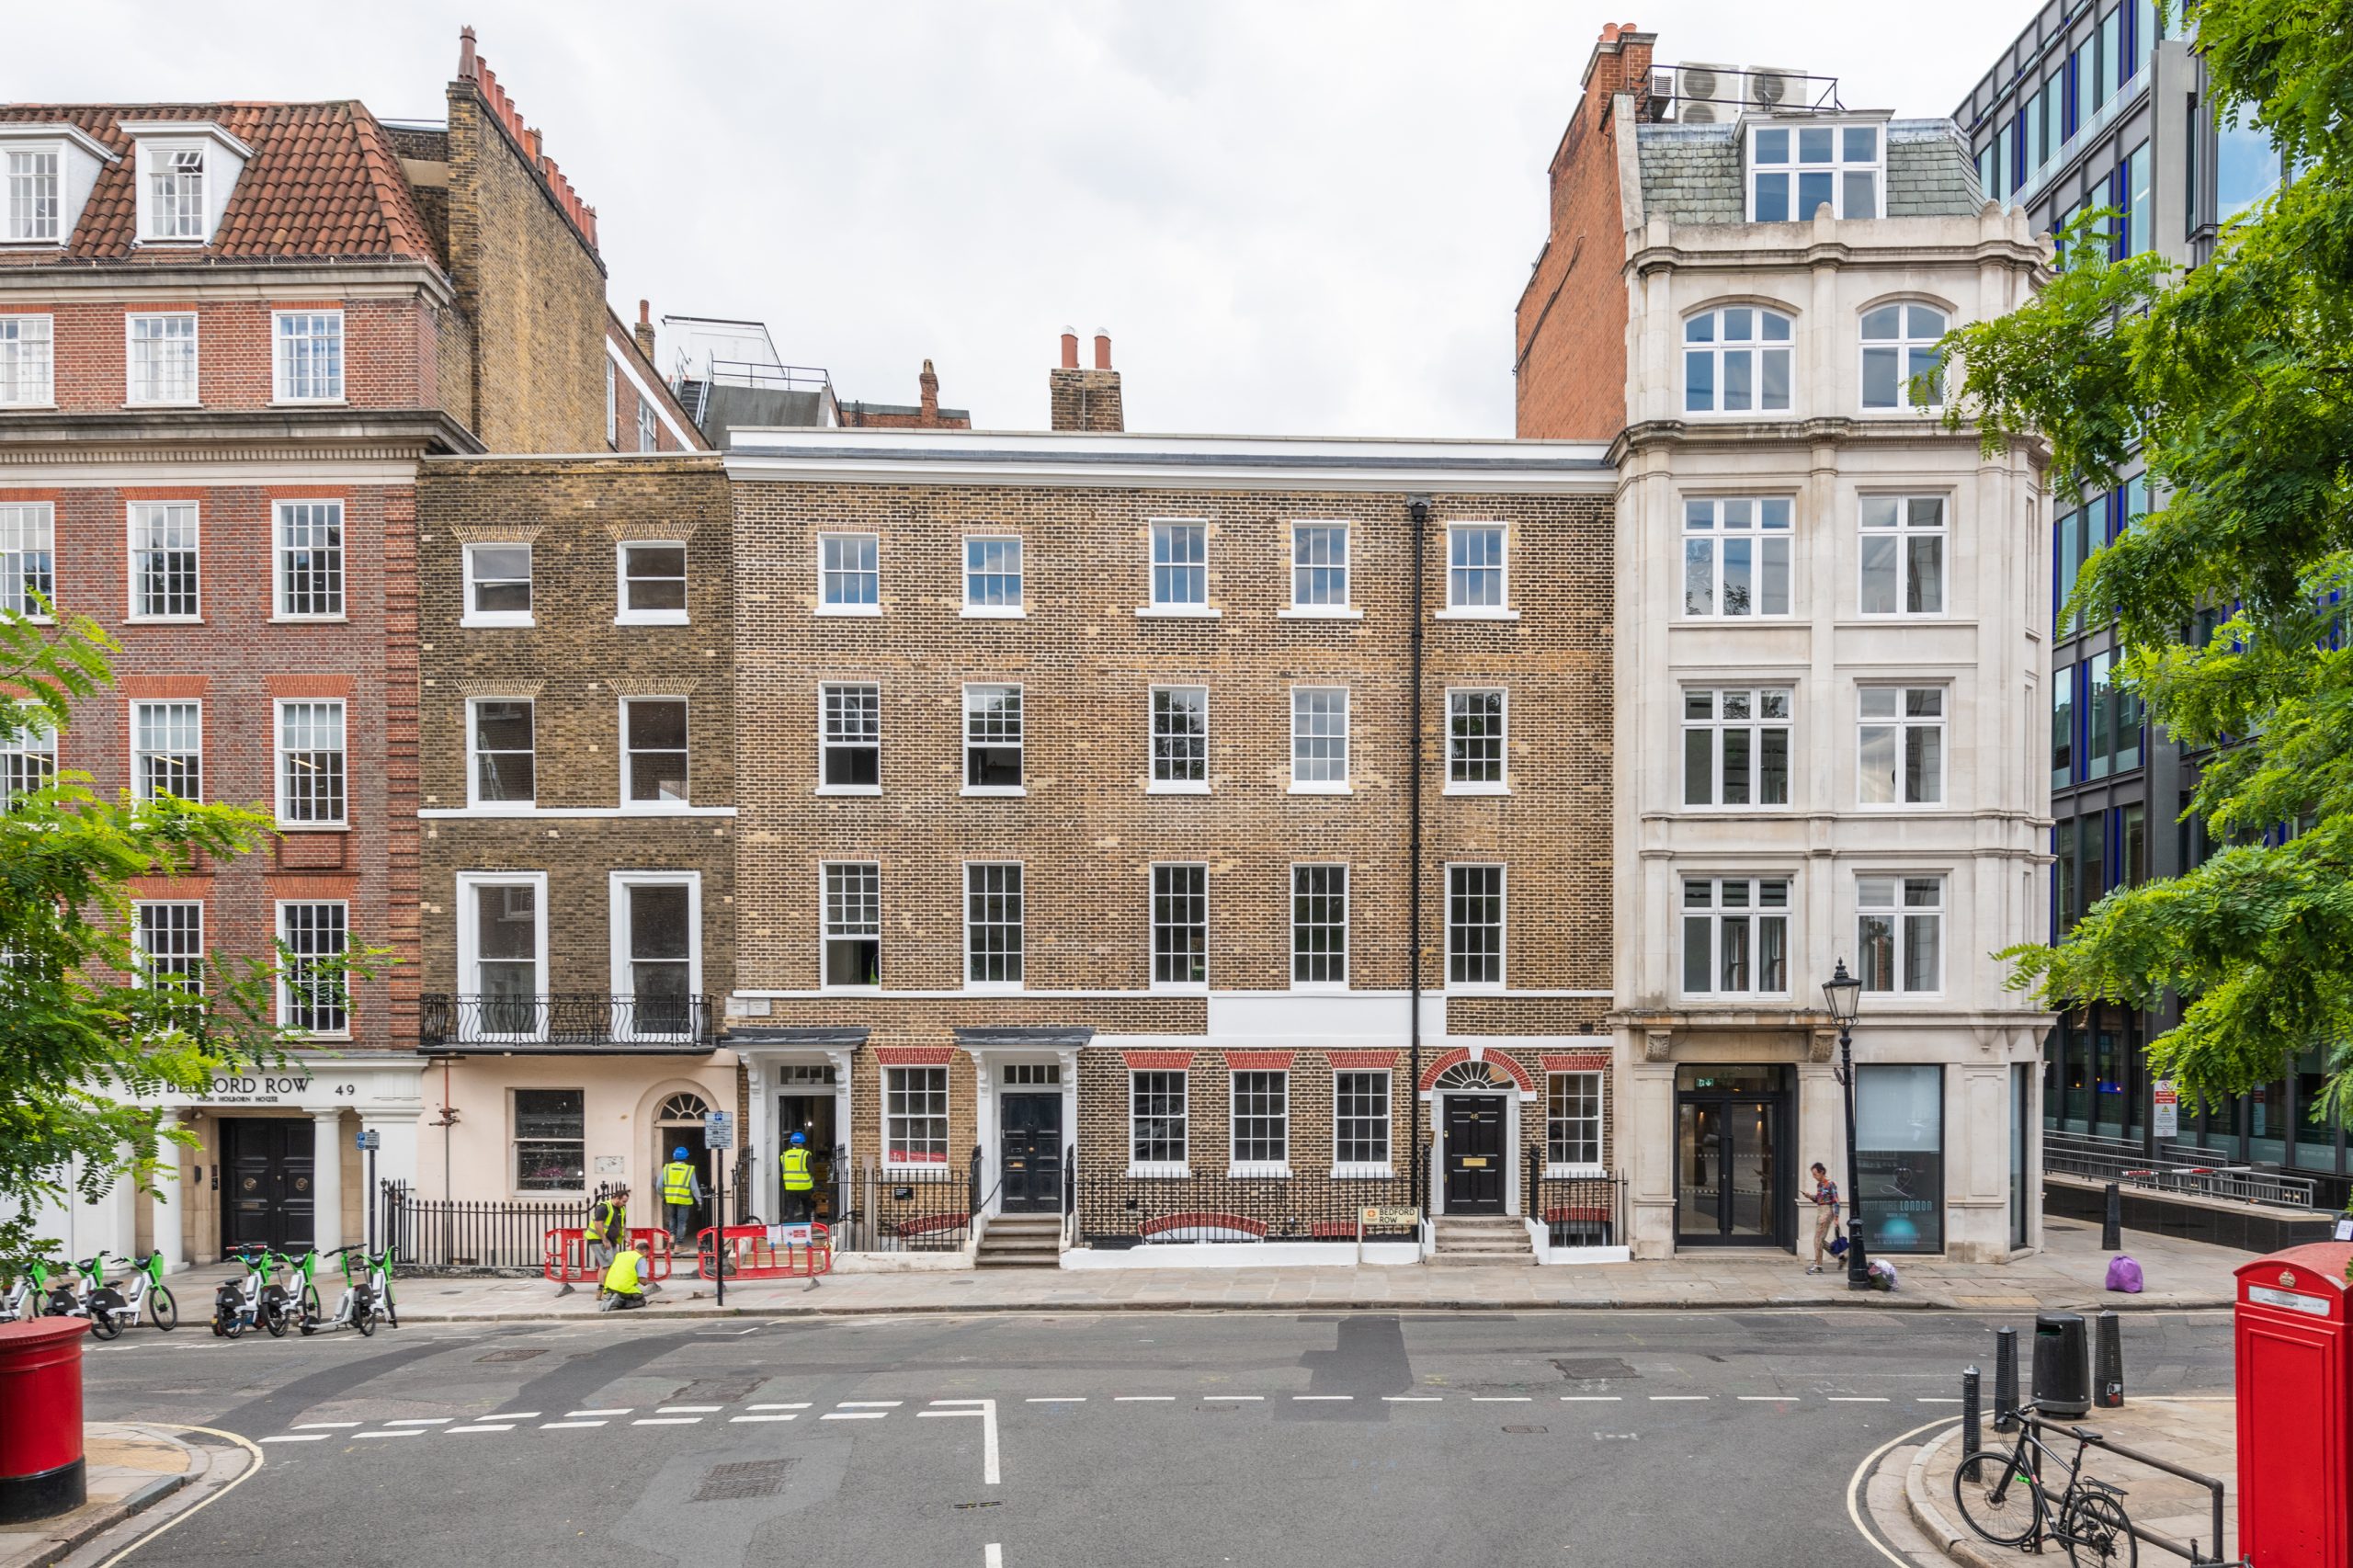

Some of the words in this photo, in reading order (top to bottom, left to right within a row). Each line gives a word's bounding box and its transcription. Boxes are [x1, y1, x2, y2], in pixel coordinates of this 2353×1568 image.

[265, 1077, 311, 1094] ROW
[335, 1084, 355, 1096] 49
[1900, 1200, 1933, 1211] LONDON
[1379, 1208, 1415, 1216] BEDFORD
